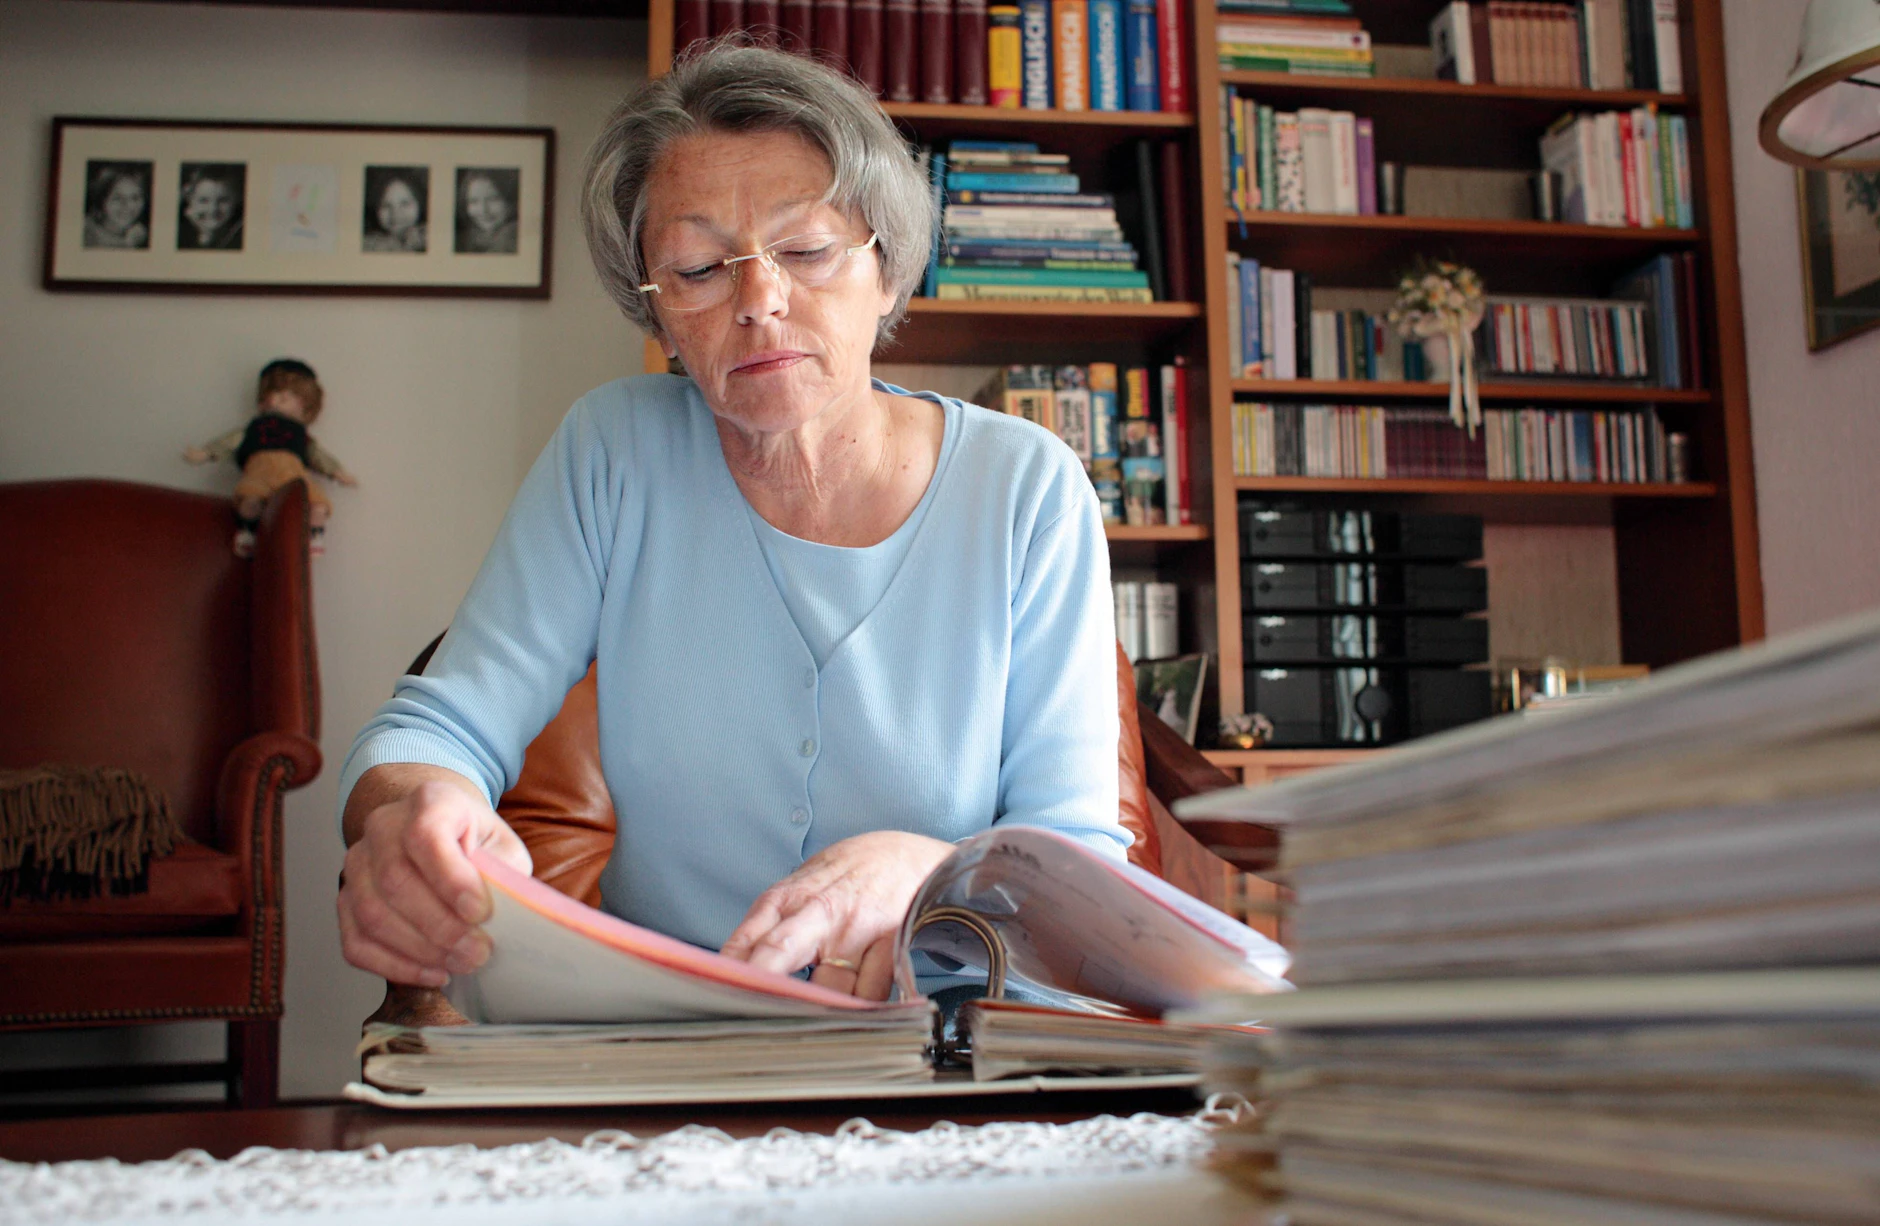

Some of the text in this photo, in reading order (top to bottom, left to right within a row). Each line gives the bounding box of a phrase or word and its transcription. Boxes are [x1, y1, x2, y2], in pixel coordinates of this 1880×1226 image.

[1025, 11, 1048, 110] ENGLISCH
[1060, 13, 1084, 112] SPANISCH
[1096, 11, 1118, 111] FRANZÖSISCH
